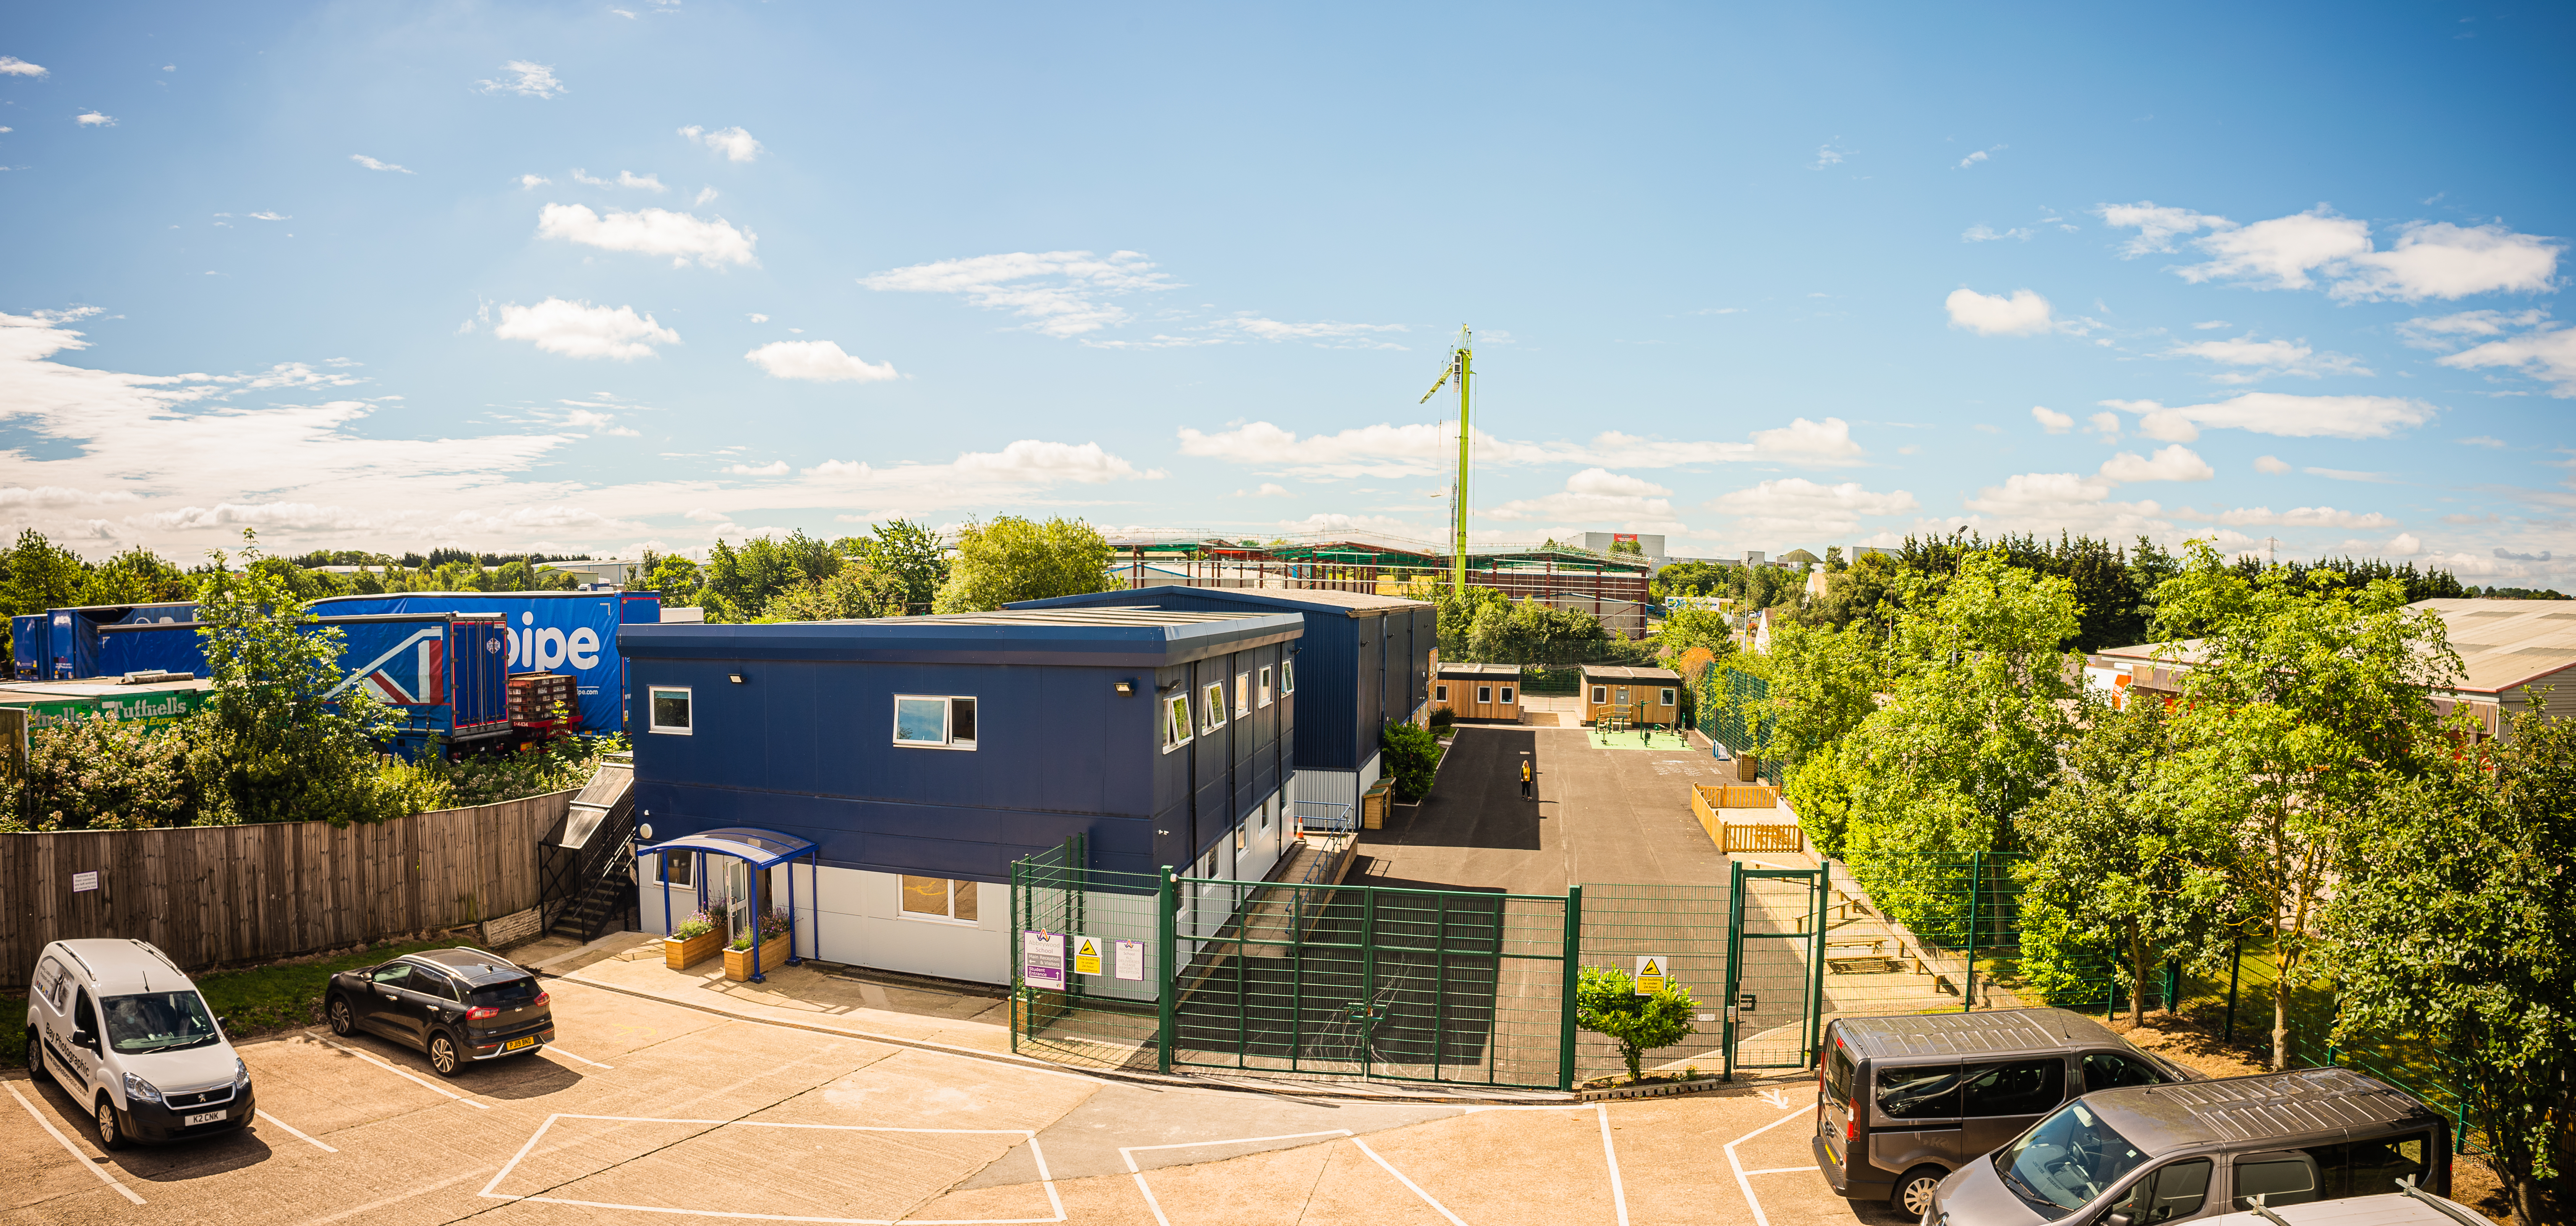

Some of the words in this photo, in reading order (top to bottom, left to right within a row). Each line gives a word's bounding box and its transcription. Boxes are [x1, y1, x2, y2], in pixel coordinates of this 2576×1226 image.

[113, 697, 186, 719] Tuffnells
[1028, 940, 1060, 948] Abbeywood
[46, 1022, 55, 1043] Bay
[55, 1033, 89, 1077] Photographic
[510, 1040, 521, 1048] PJ19
[193, 1115, 203, 1123] K2
[204, 1112, 218, 1121] CNK
